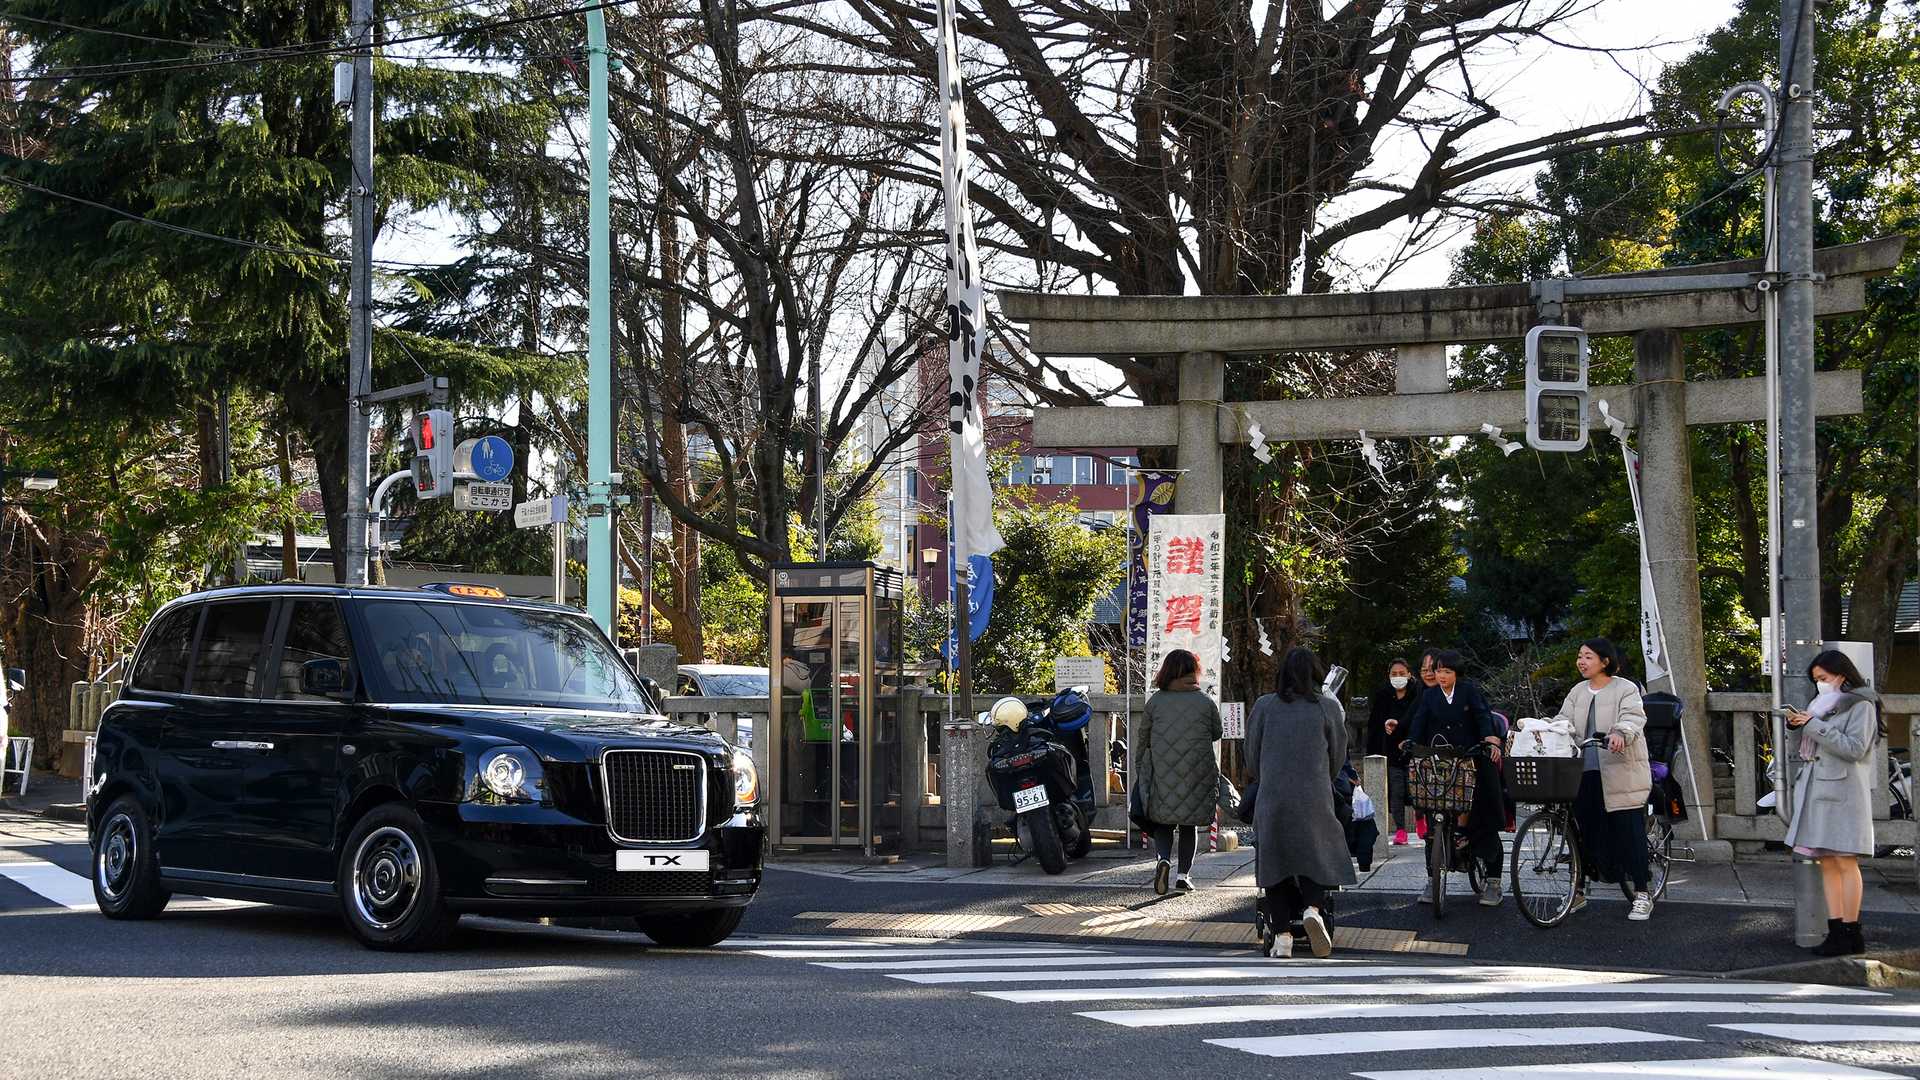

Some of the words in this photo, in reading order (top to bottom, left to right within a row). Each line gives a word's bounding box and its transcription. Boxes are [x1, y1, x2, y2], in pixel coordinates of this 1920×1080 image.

[471, 486, 510, 496] 自転車通行可
[472, 497, 510, 506] ここから
[455, 587, 500, 596] TAXI
[1016, 791, 1045, 806] 95-61
[644, 856, 681, 866] TX
